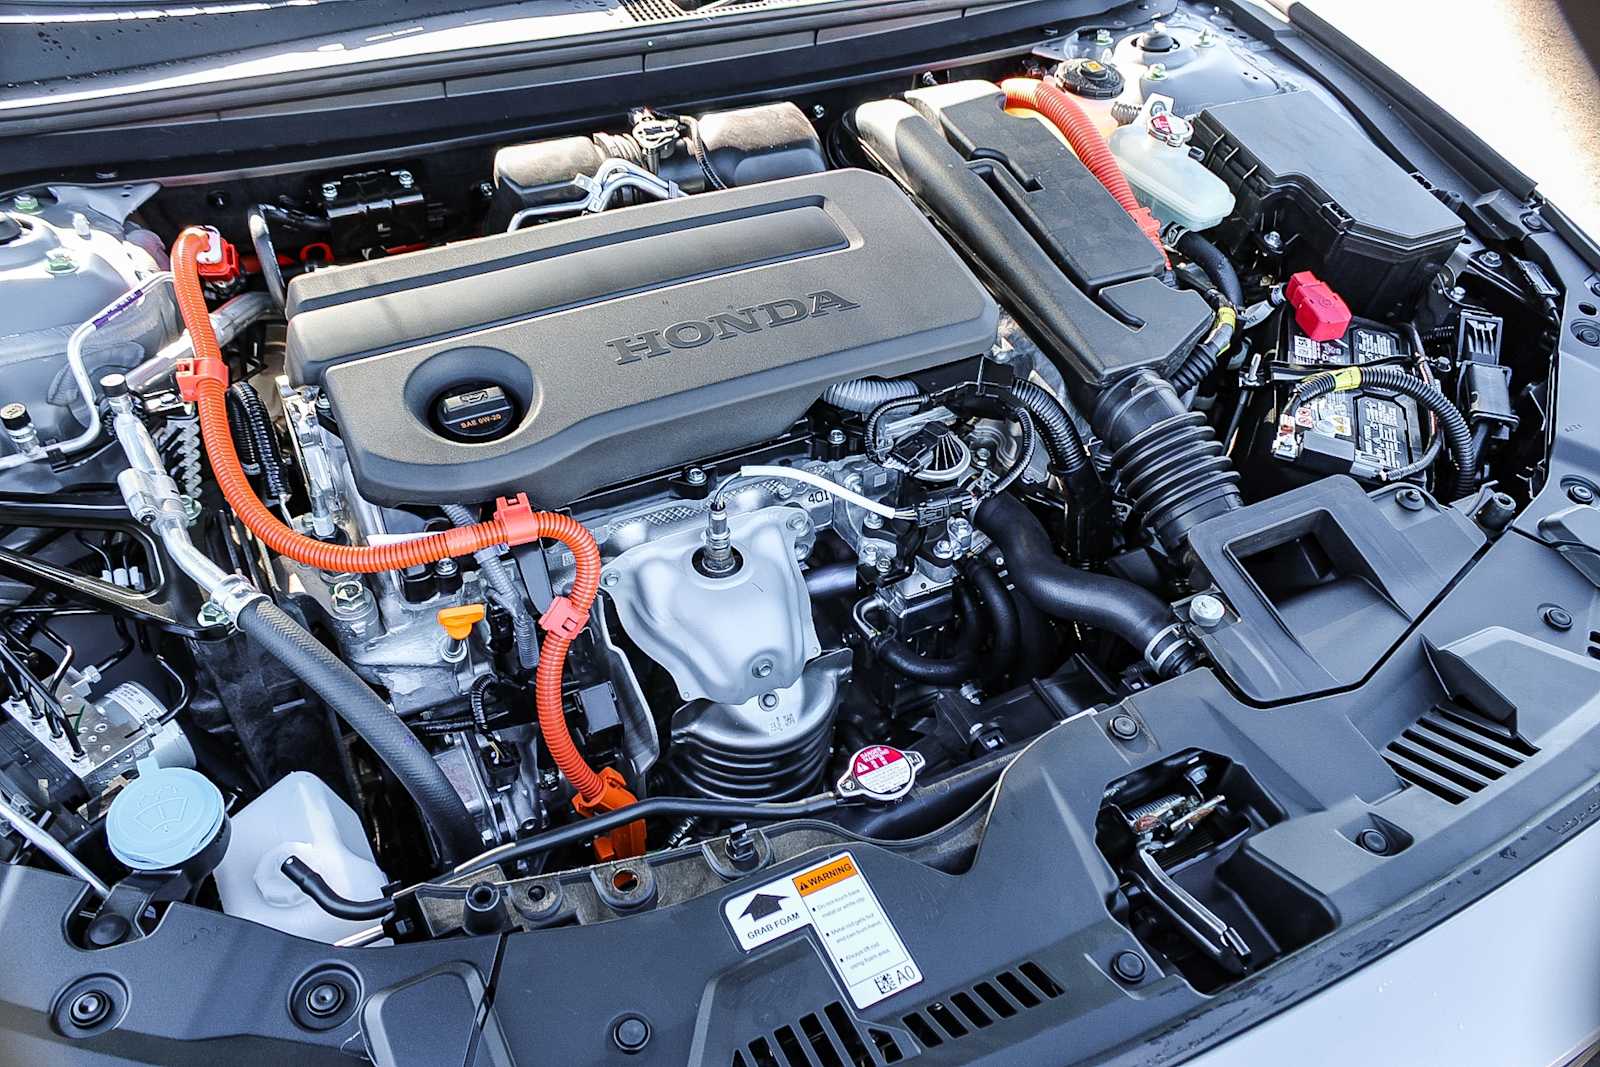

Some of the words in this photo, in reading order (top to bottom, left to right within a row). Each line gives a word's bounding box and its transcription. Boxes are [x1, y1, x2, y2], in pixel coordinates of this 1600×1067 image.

[606, 289, 861, 365] HONDA
[460, 419, 477, 429] SAE
[477, 413, 502, 425] 0W-20
[809, 863, 853, 886] WARNING
[747, 924, 774, 940] GRAB
[775, 912, 800, 929] FOAM
